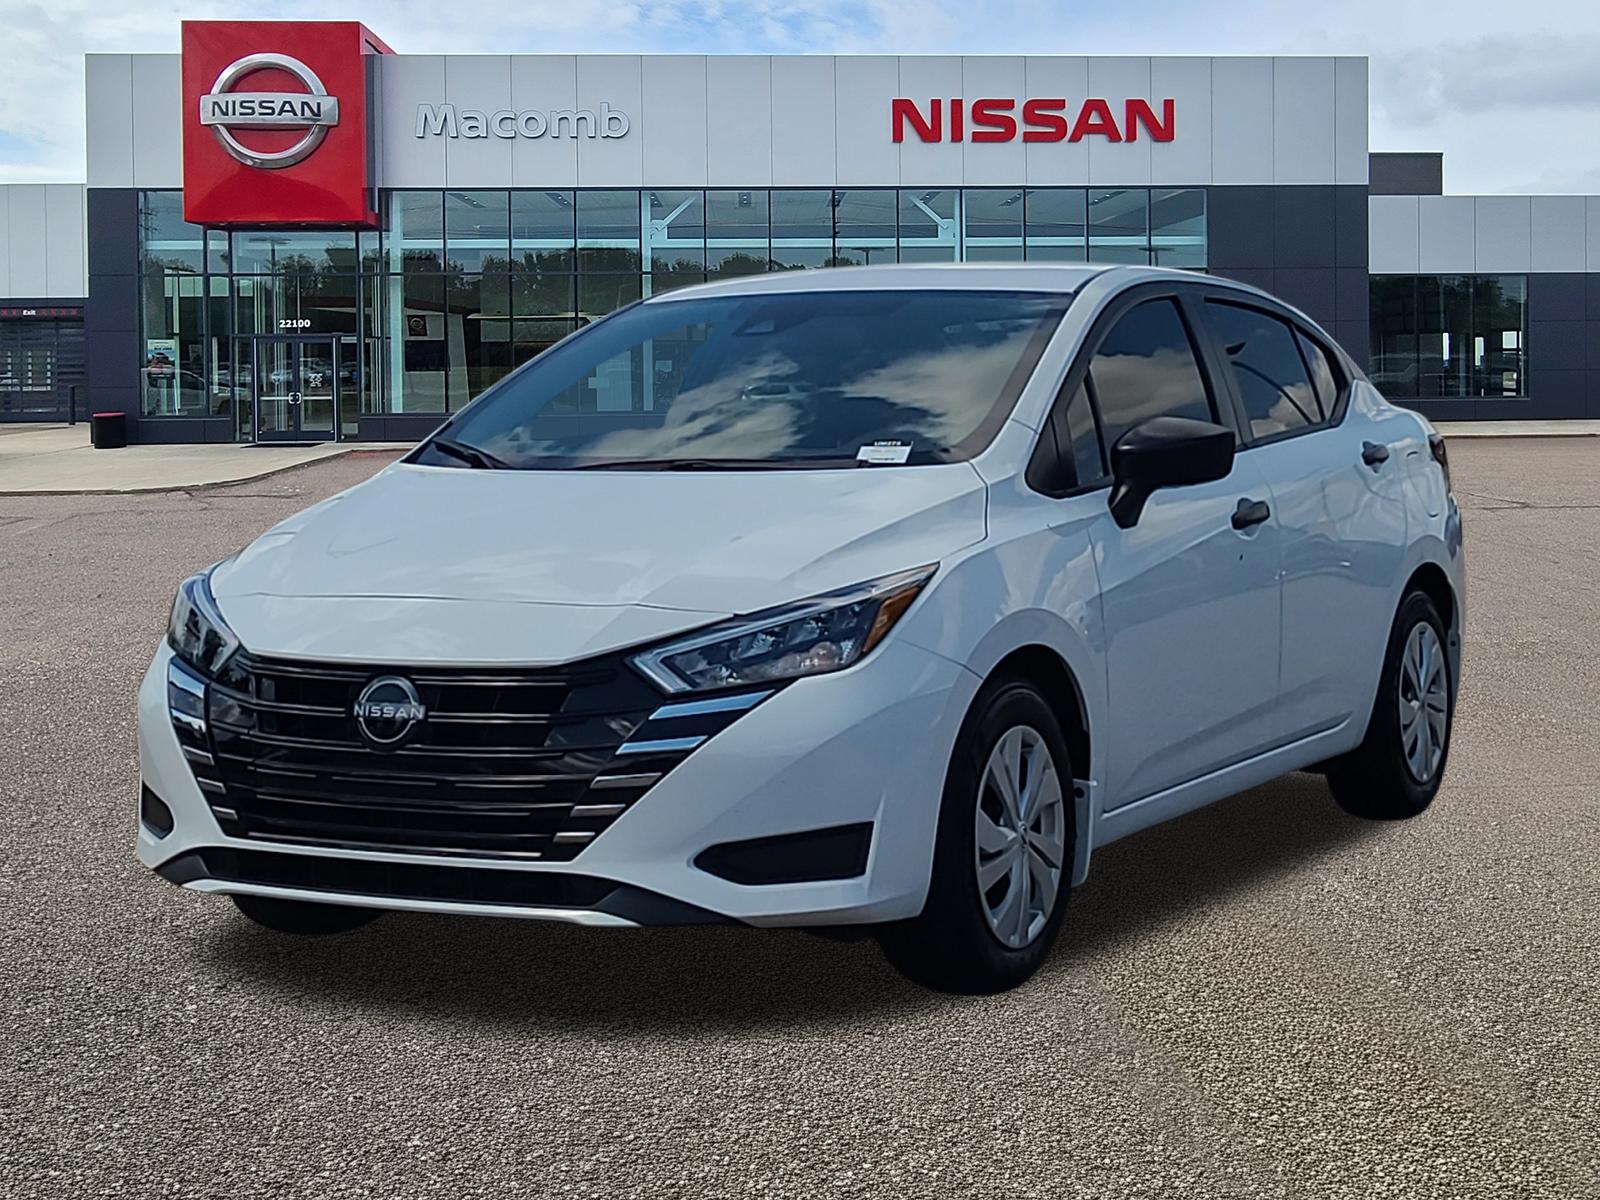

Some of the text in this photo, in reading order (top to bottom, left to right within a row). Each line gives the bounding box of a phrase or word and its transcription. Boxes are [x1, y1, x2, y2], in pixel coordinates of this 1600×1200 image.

[211, 100, 322, 117] NISSAN
[415, 101, 630, 138] Macomb
[892, 98, 1176, 143] NISSAN
[279, 319, 311, 328] 22100
[353, 703, 424, 719] NISSAN
